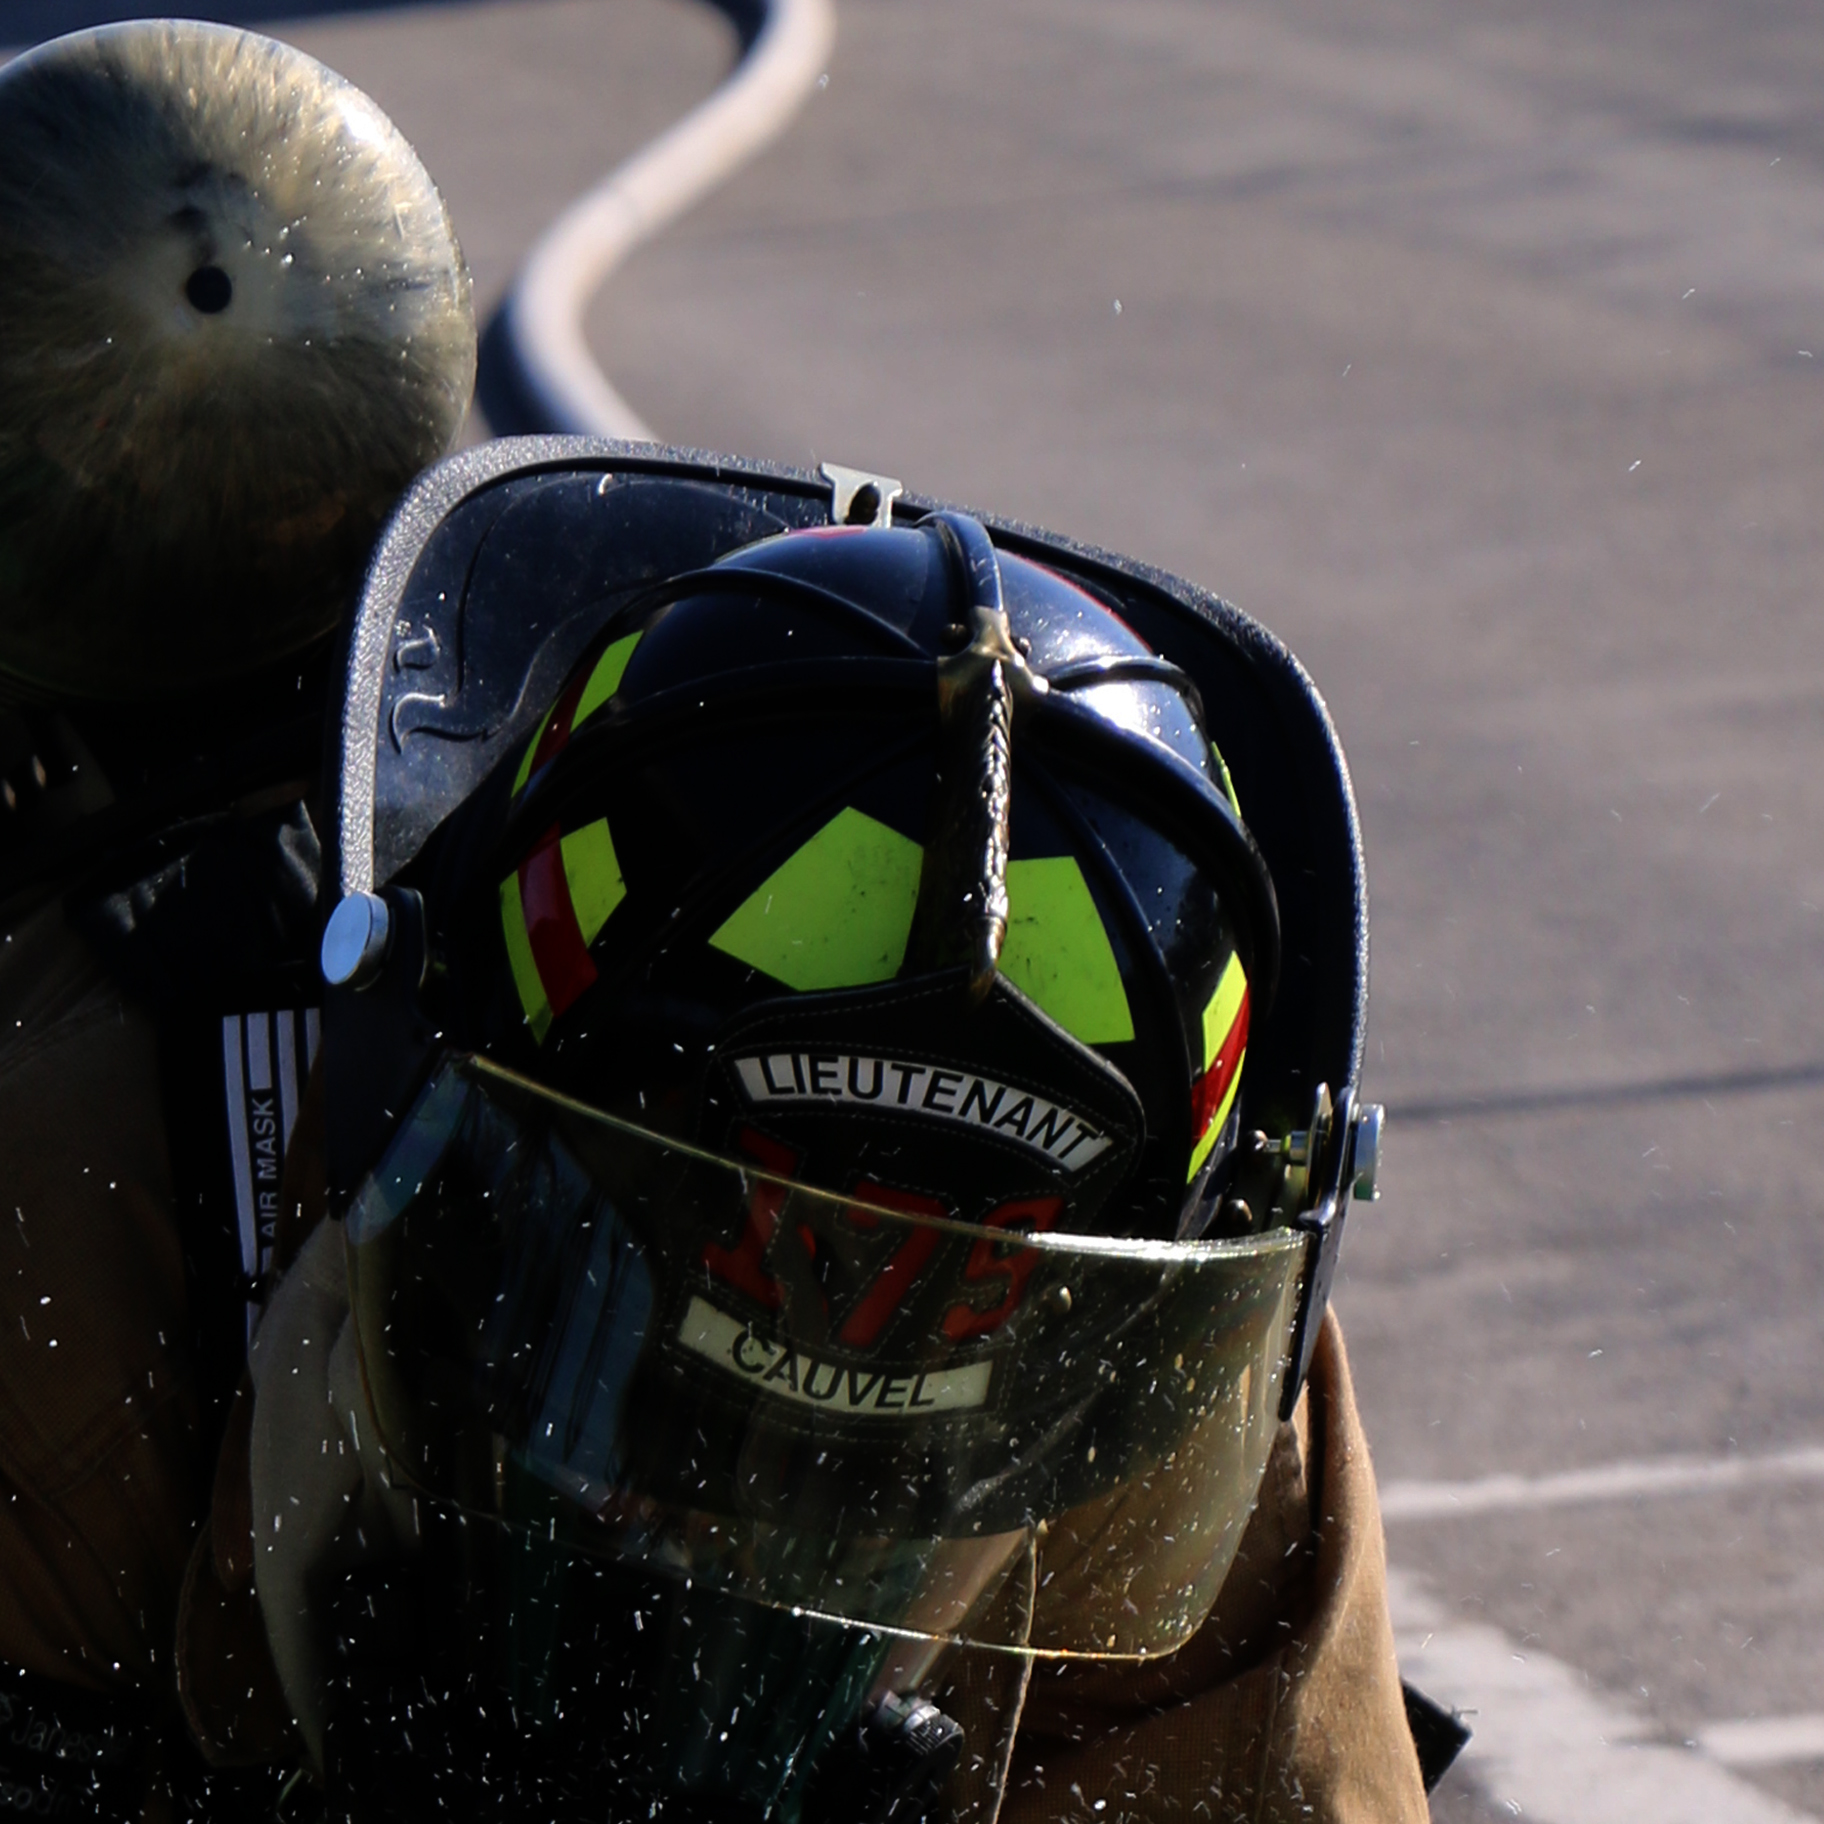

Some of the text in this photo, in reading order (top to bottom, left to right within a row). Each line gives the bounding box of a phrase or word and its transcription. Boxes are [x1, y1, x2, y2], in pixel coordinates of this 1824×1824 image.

[759, 1054, 1100, 1162] LIEUTENANT
[252, 1096, 279, 1238] AIR MASK
[731, 1331, 936, 1408] CAUVEL
